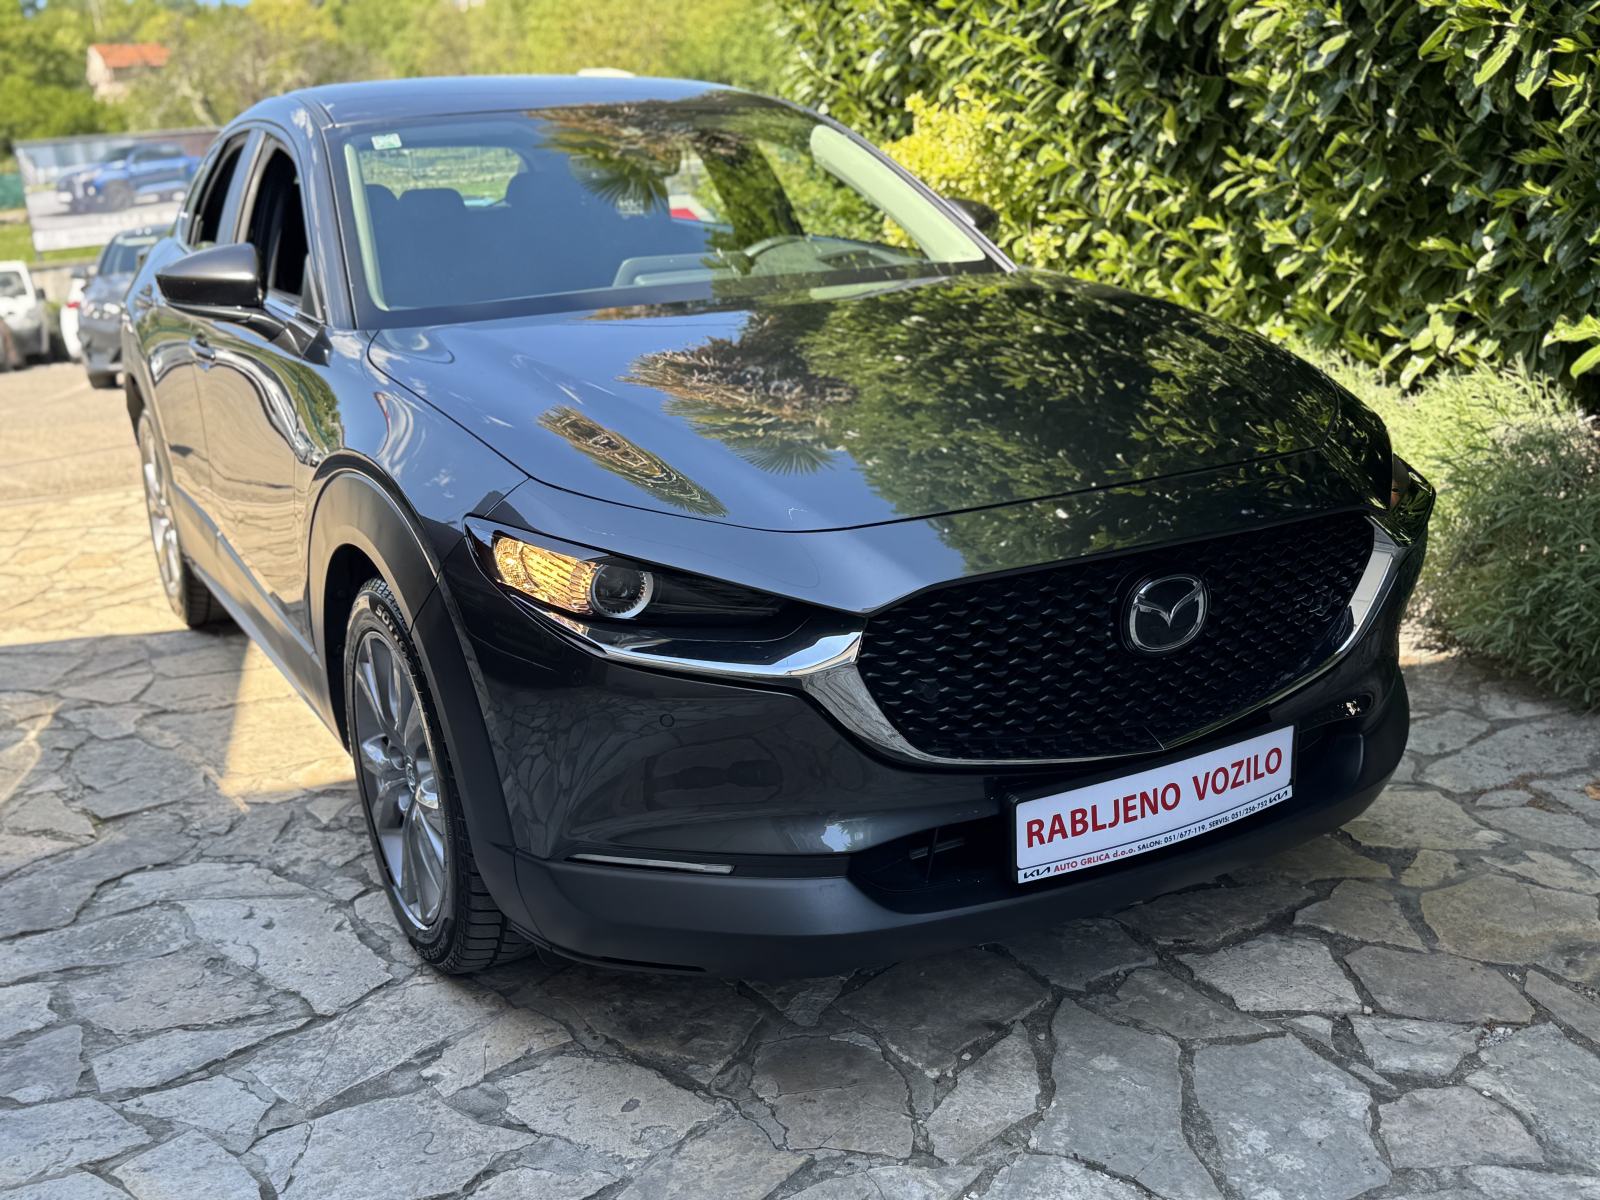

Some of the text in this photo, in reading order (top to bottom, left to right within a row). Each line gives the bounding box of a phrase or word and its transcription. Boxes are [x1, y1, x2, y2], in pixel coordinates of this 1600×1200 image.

[1026, 747, 1283, 848] RABLJENO VOZILO
[1053, 860, 1078, 873] AUTO
[1080, 852, 1110, 866] GRLICA
[1112, 847, 1136, 858] d.o.o.
[1137, 839, 1163, 850] SALON:
[1209, 816, 1230, 828] SERVIS:
[1231, 801, 1268, 819] 051/256-752
